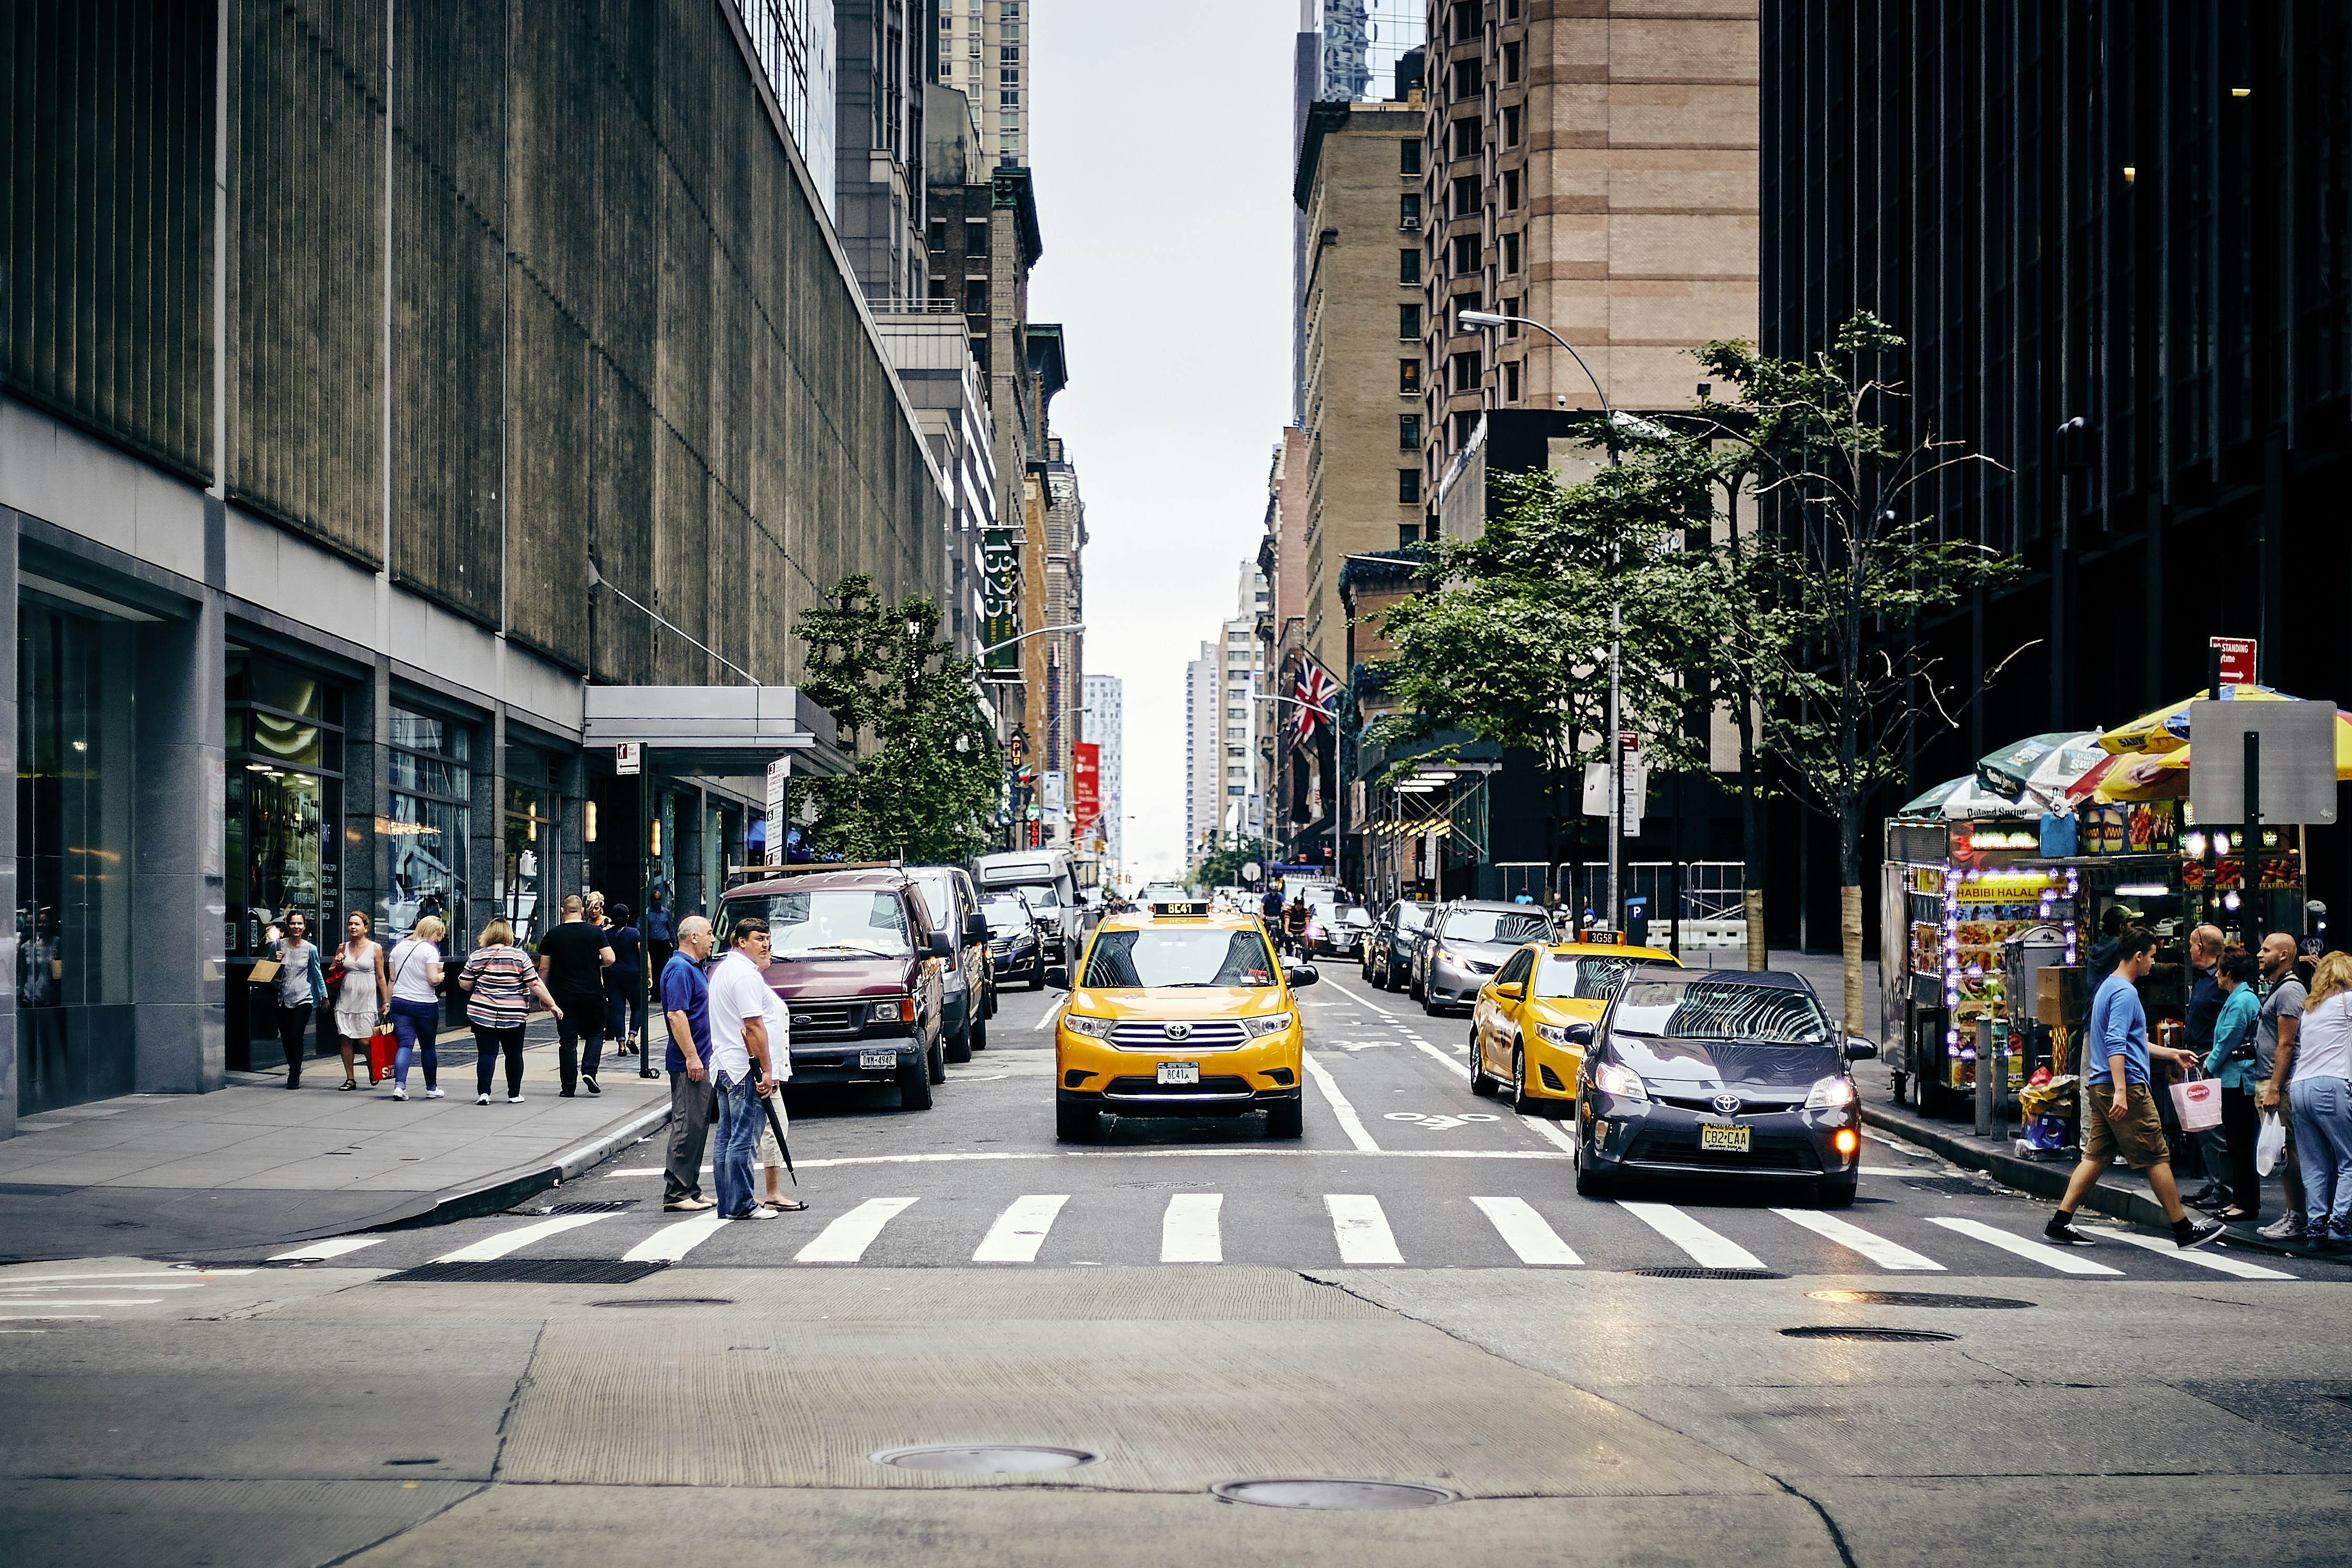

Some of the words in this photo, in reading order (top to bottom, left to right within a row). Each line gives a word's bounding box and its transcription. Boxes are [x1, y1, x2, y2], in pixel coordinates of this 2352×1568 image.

[984, 539, 1013, 618] 1325
[2222, 643, 2248, 653] STANDING
[1012, 742, 1021, 765] PUB
[769, 765, 774, 774] 3
[768, 811, 772, 821] 6
[1957, 888, 1994, 897] HABIBI
[1998, 887, 2035, 896] HALAL
[1168, 904, 1192, 914] 8C41
[1634, 906, 1641, 918] P
[1592, 933, 1613, 943] 3G58
